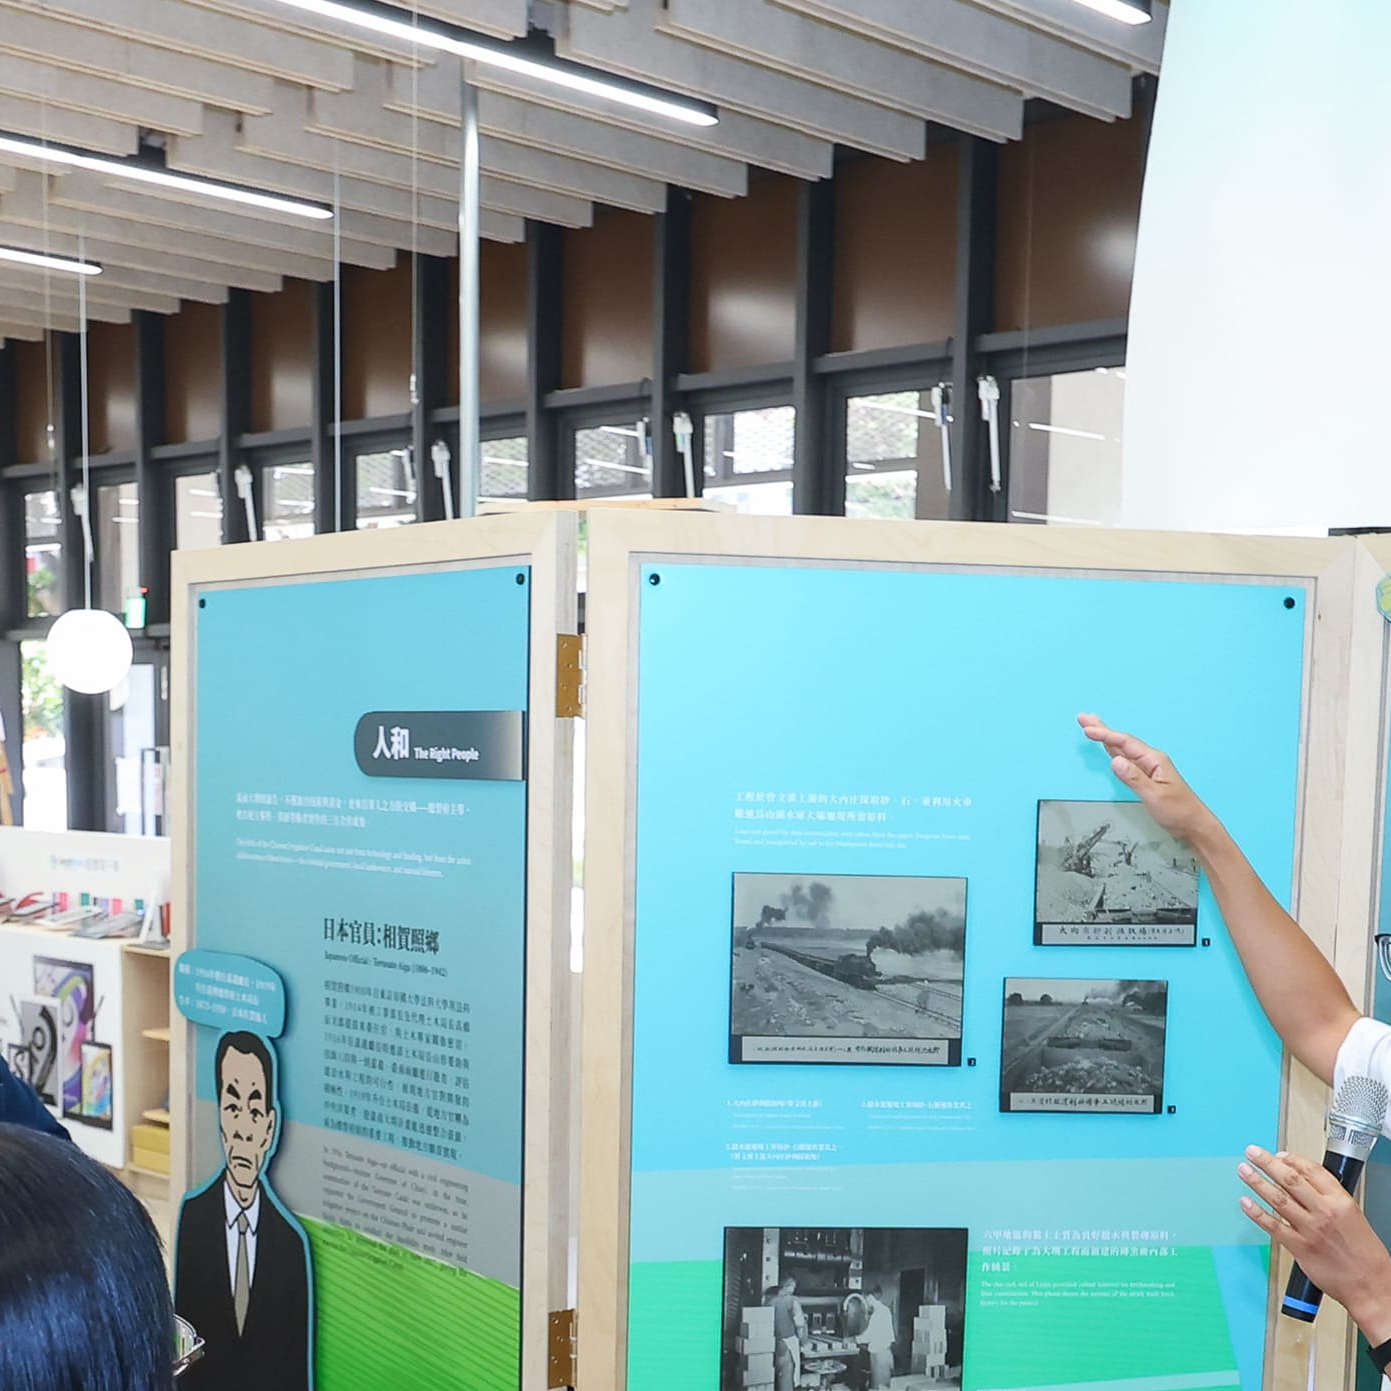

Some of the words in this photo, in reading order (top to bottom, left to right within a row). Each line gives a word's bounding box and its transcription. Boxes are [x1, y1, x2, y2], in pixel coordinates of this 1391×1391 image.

[372, 725, 410, 760] 人和
[414, 747, 428, 760] The
[430, 747, 450, 762] Right
[452, 748, 479, 763] People
